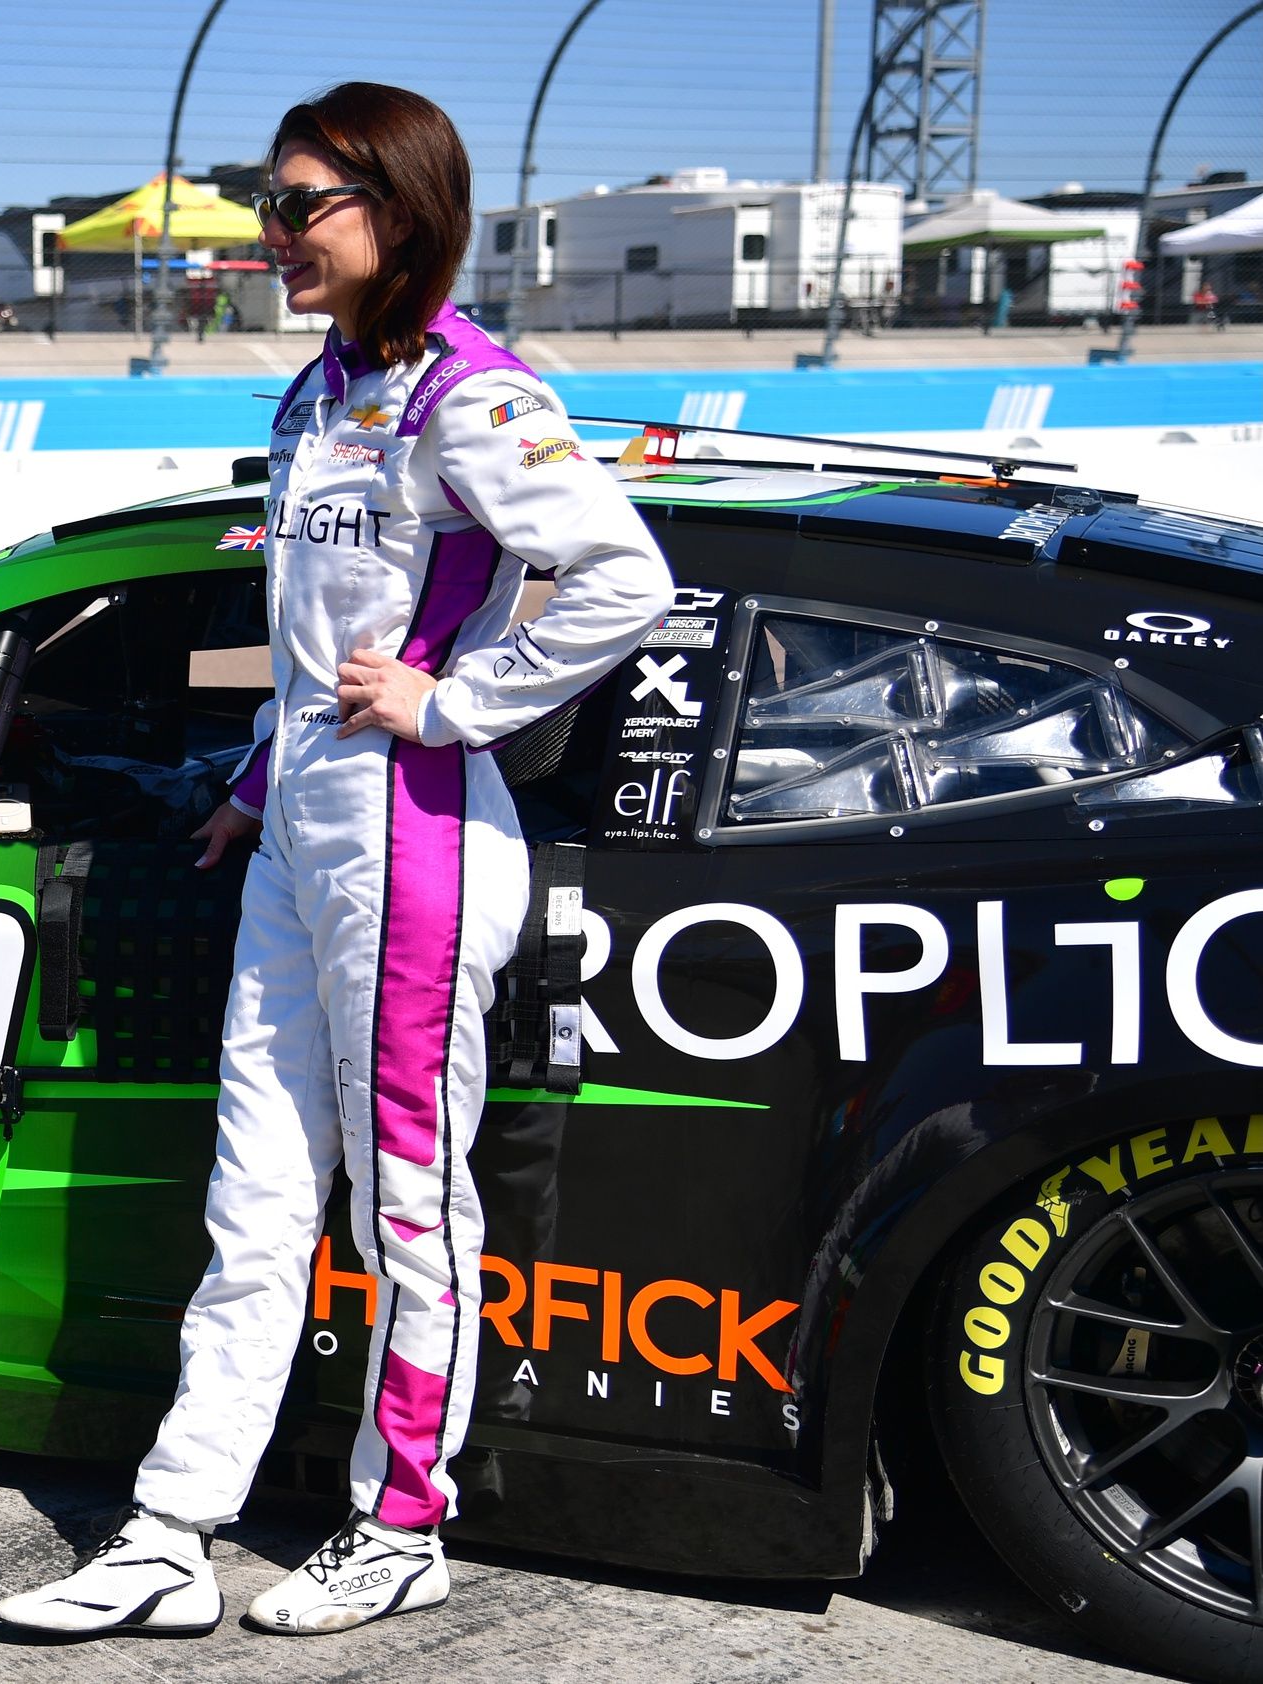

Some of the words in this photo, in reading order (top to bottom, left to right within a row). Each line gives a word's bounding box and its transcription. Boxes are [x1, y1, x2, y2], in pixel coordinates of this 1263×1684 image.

[407, 359, 469, 425] sparco
[526, 440, 578, 467] SUNOCO
[665, 619, 707, 630] NASCAR
[651, 632, 671, 641] CUP
[671, 632, 705, 642] SERIES
[1103, 629, 1230, 649] OAKLEY
[630, 653, 703, 716] XL
[300, 711, 343, 726] KATHE
[624, 717, 700, 728] XEROPROJECT
[621, 729, 657, 738] LIVERY
[312, 1235, 801, 1394] HRFICK
[328, 1567, 392, 1597] sparco
